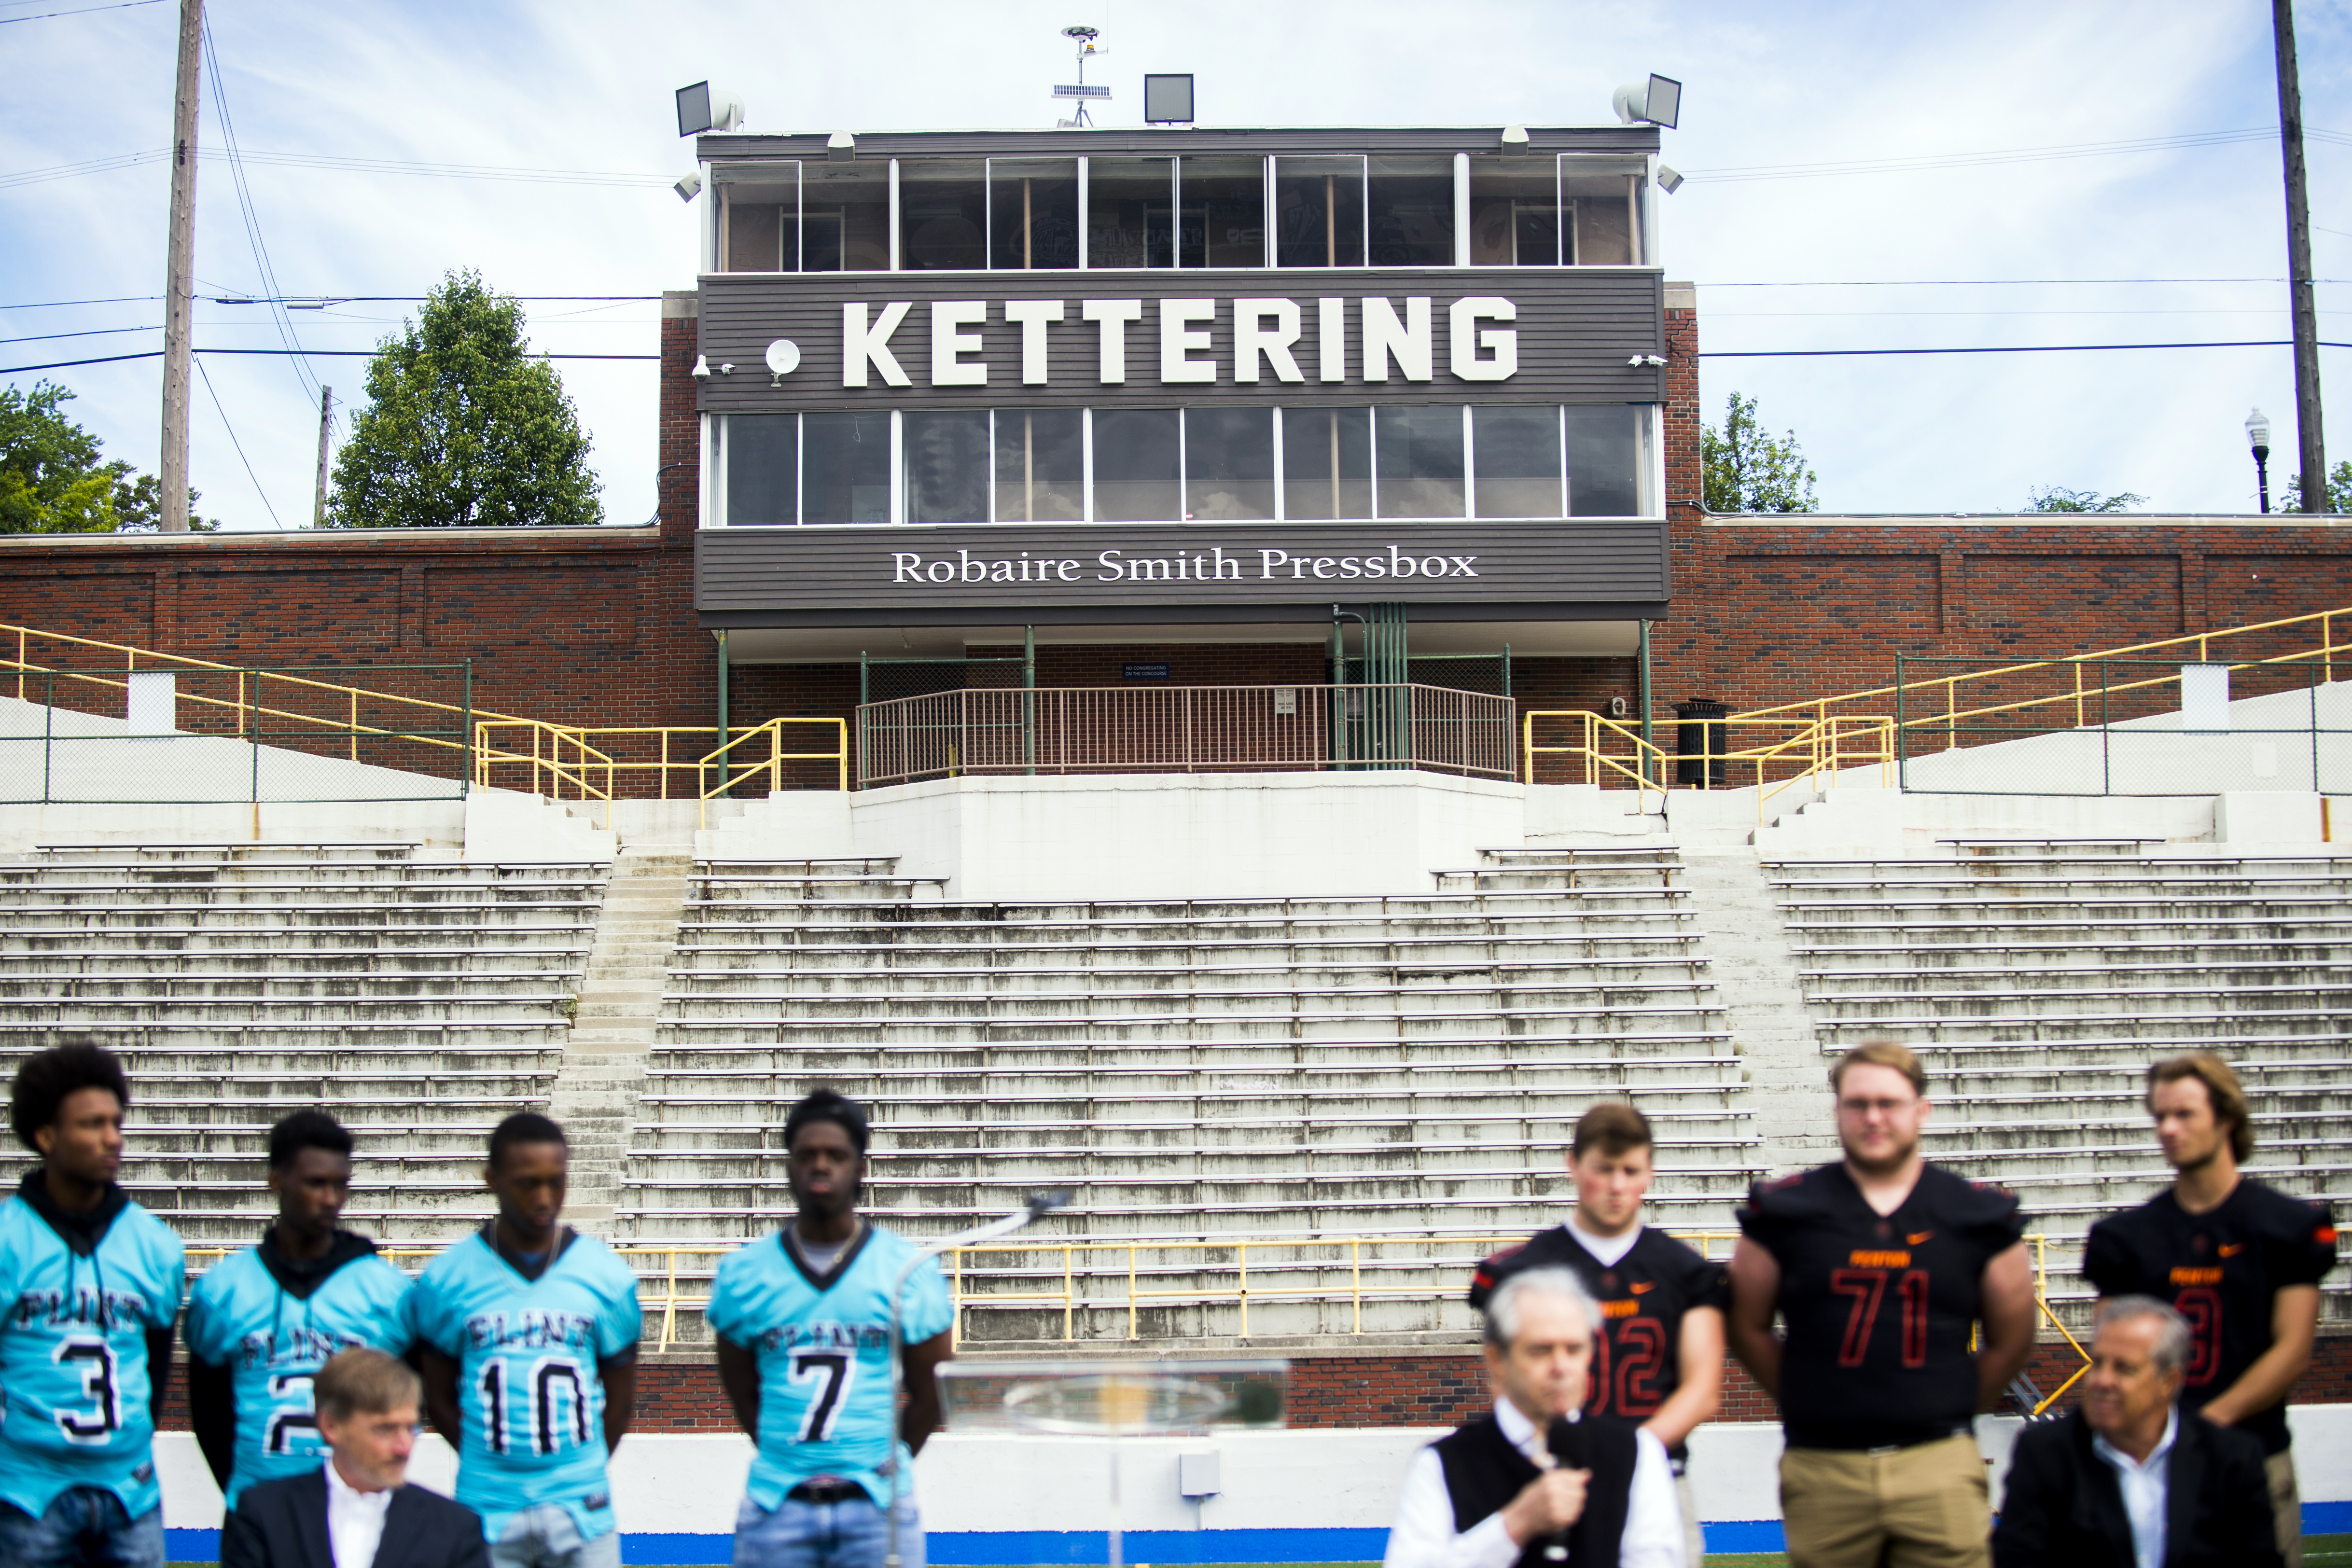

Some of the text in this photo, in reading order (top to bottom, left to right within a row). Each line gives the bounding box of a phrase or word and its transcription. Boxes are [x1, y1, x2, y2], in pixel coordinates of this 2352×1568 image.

[842, 296, 1518, 387] KETTERING
[891, 545, 1479, 583] Robaire Smith Pressbox
[1832, 1268, 1929, 1369] 71
[51, 1335, 122, 1445] 3
[476, 1356, 594, 1457] 10
[787, 1346, 858, 1446] 7
